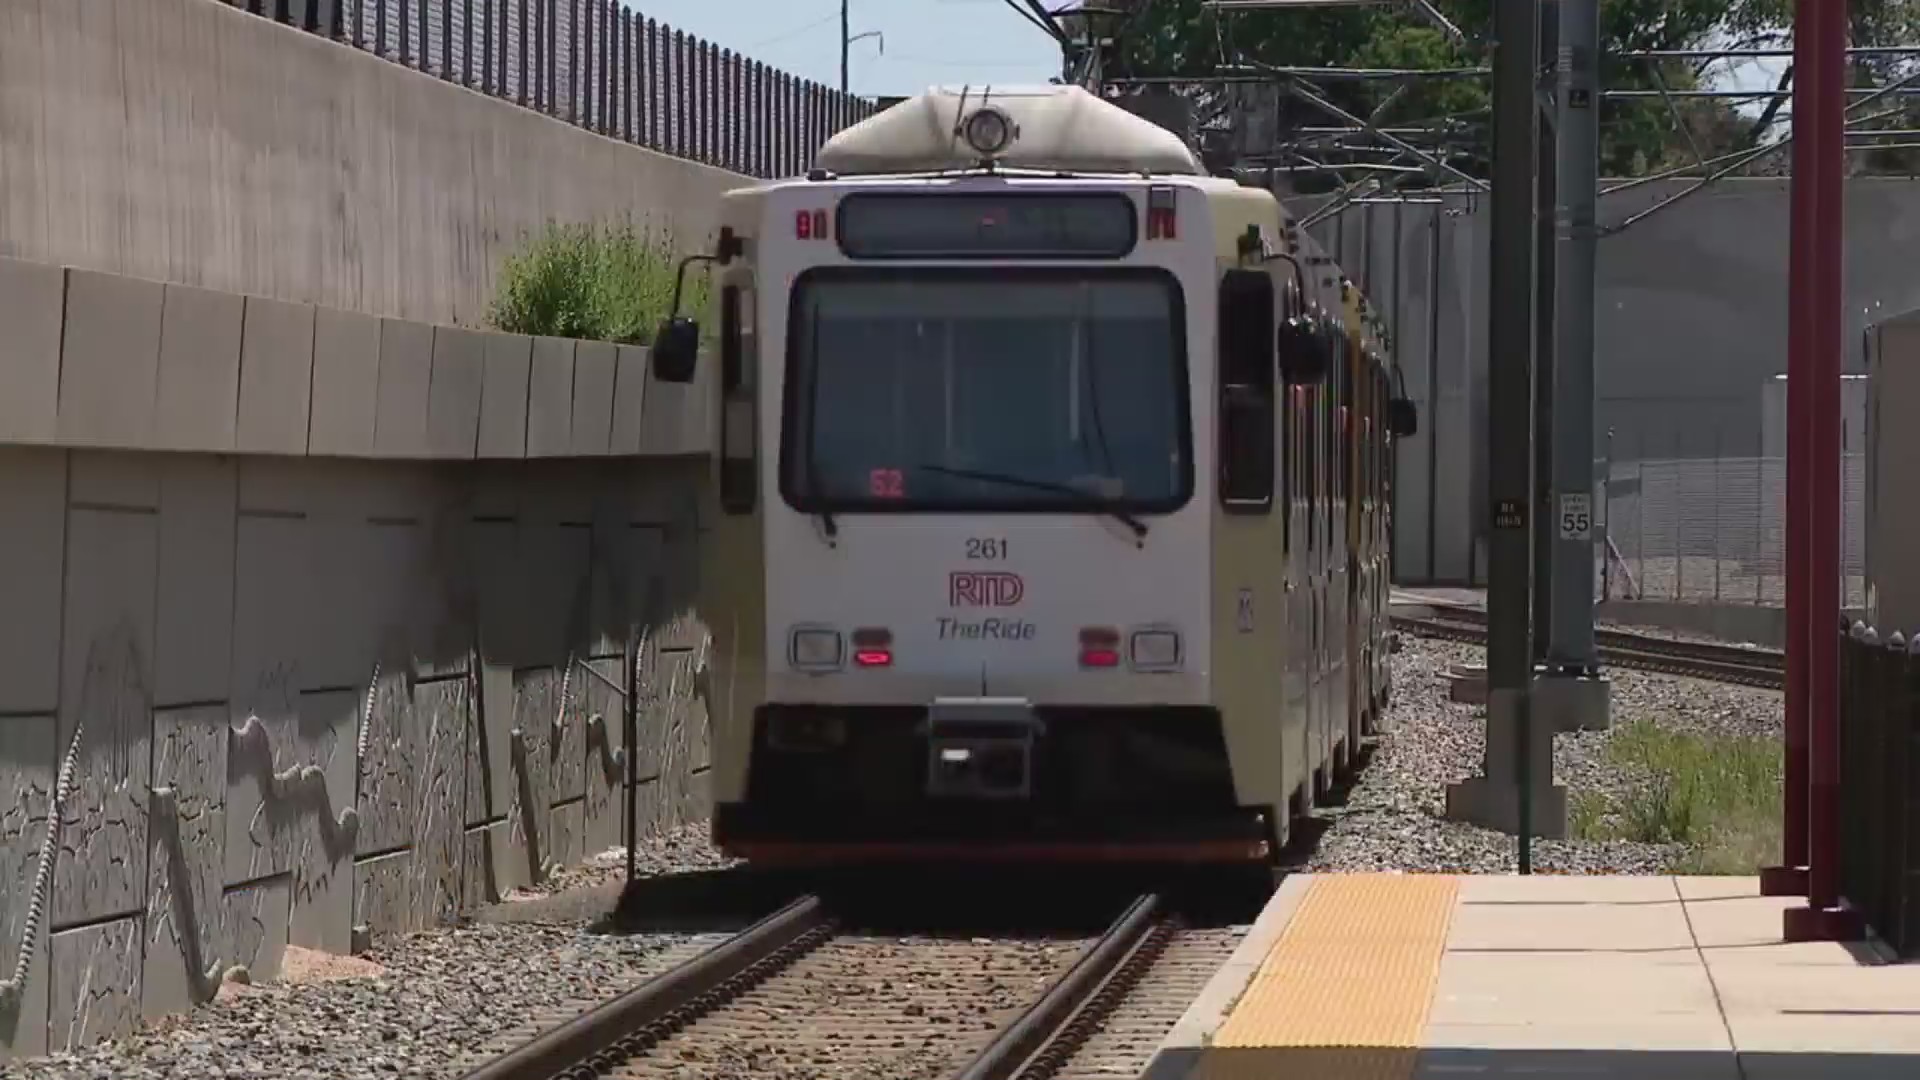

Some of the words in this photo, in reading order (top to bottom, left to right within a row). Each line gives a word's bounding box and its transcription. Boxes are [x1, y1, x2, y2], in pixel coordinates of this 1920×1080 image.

[1562, 513, 1588, 532] 55
[966, 538, 1007, 559] 261
[949, 571, 1024, 606] RTD
